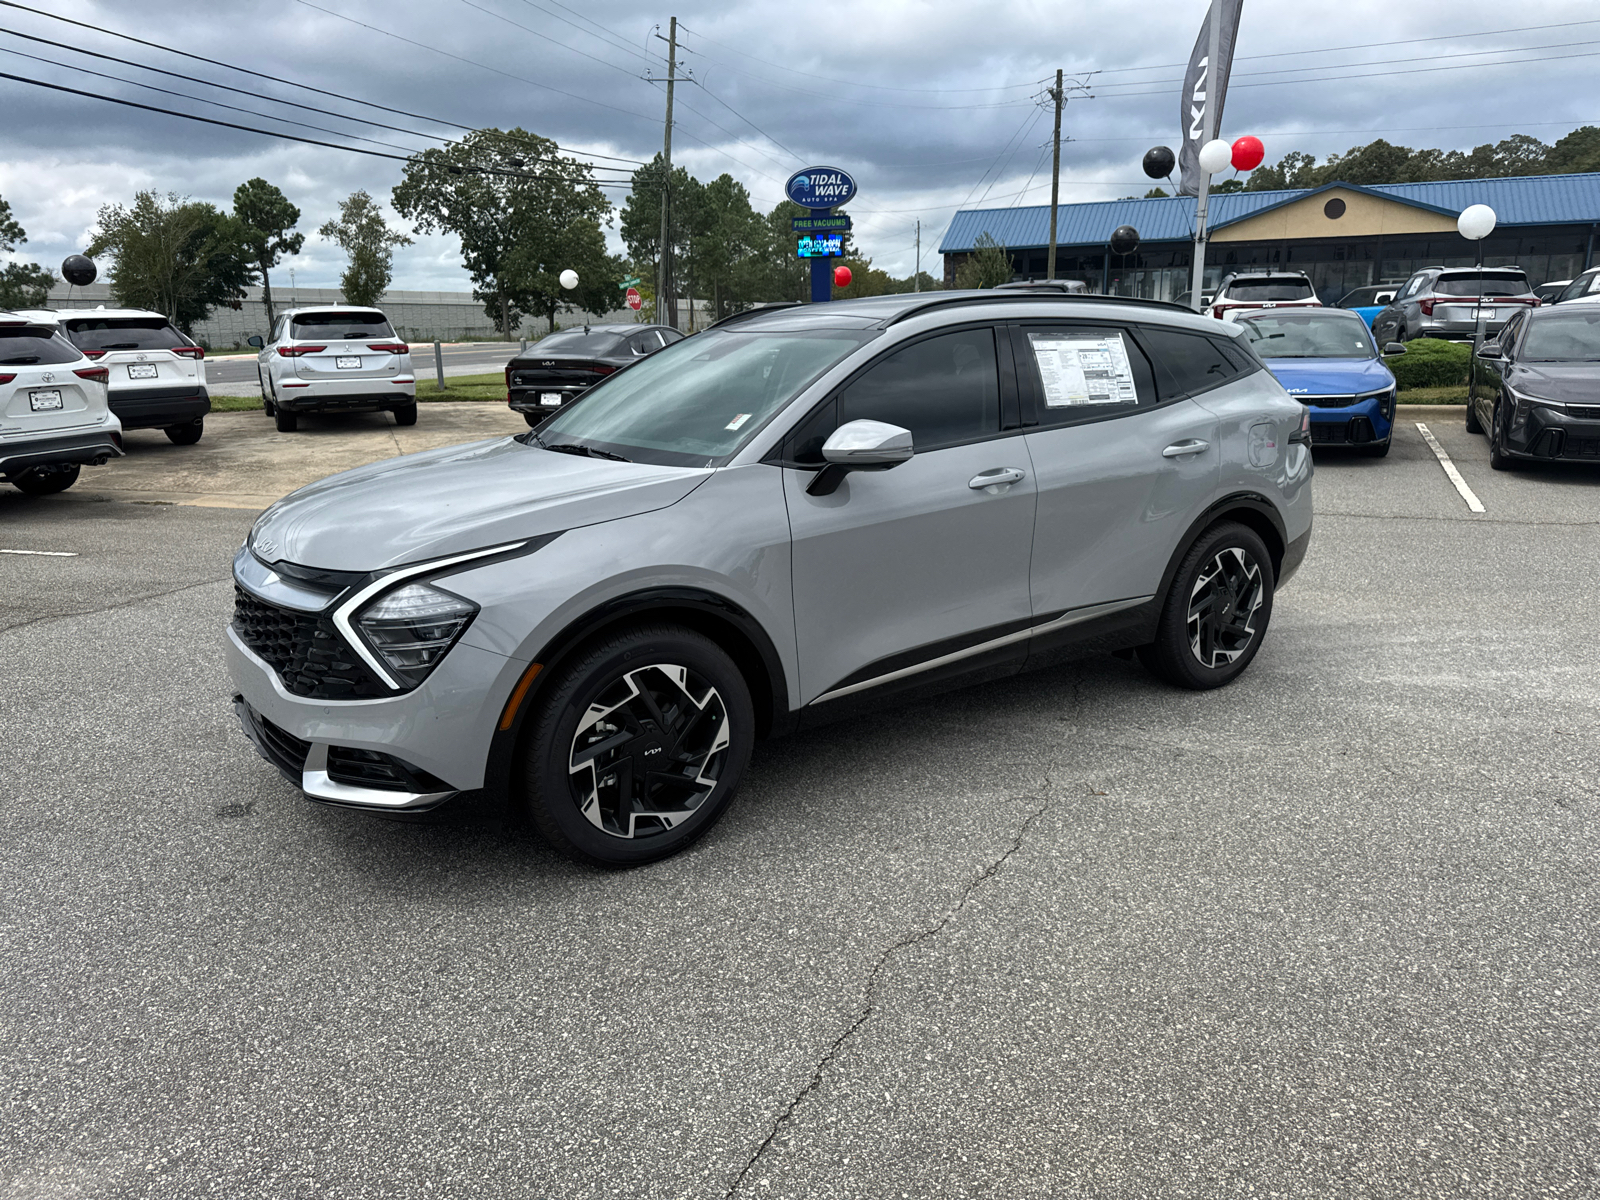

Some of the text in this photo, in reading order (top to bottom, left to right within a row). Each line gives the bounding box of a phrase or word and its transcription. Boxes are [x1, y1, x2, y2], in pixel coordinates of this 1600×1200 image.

[810, 174, 842, 185] TIDAL
[815, 185, 849, 196] WAVE
[794, 218, 846, 228] FREE VACUUMS
[628, 295, 640, 304] STOP
[257, 536, 279, 556] KIA
